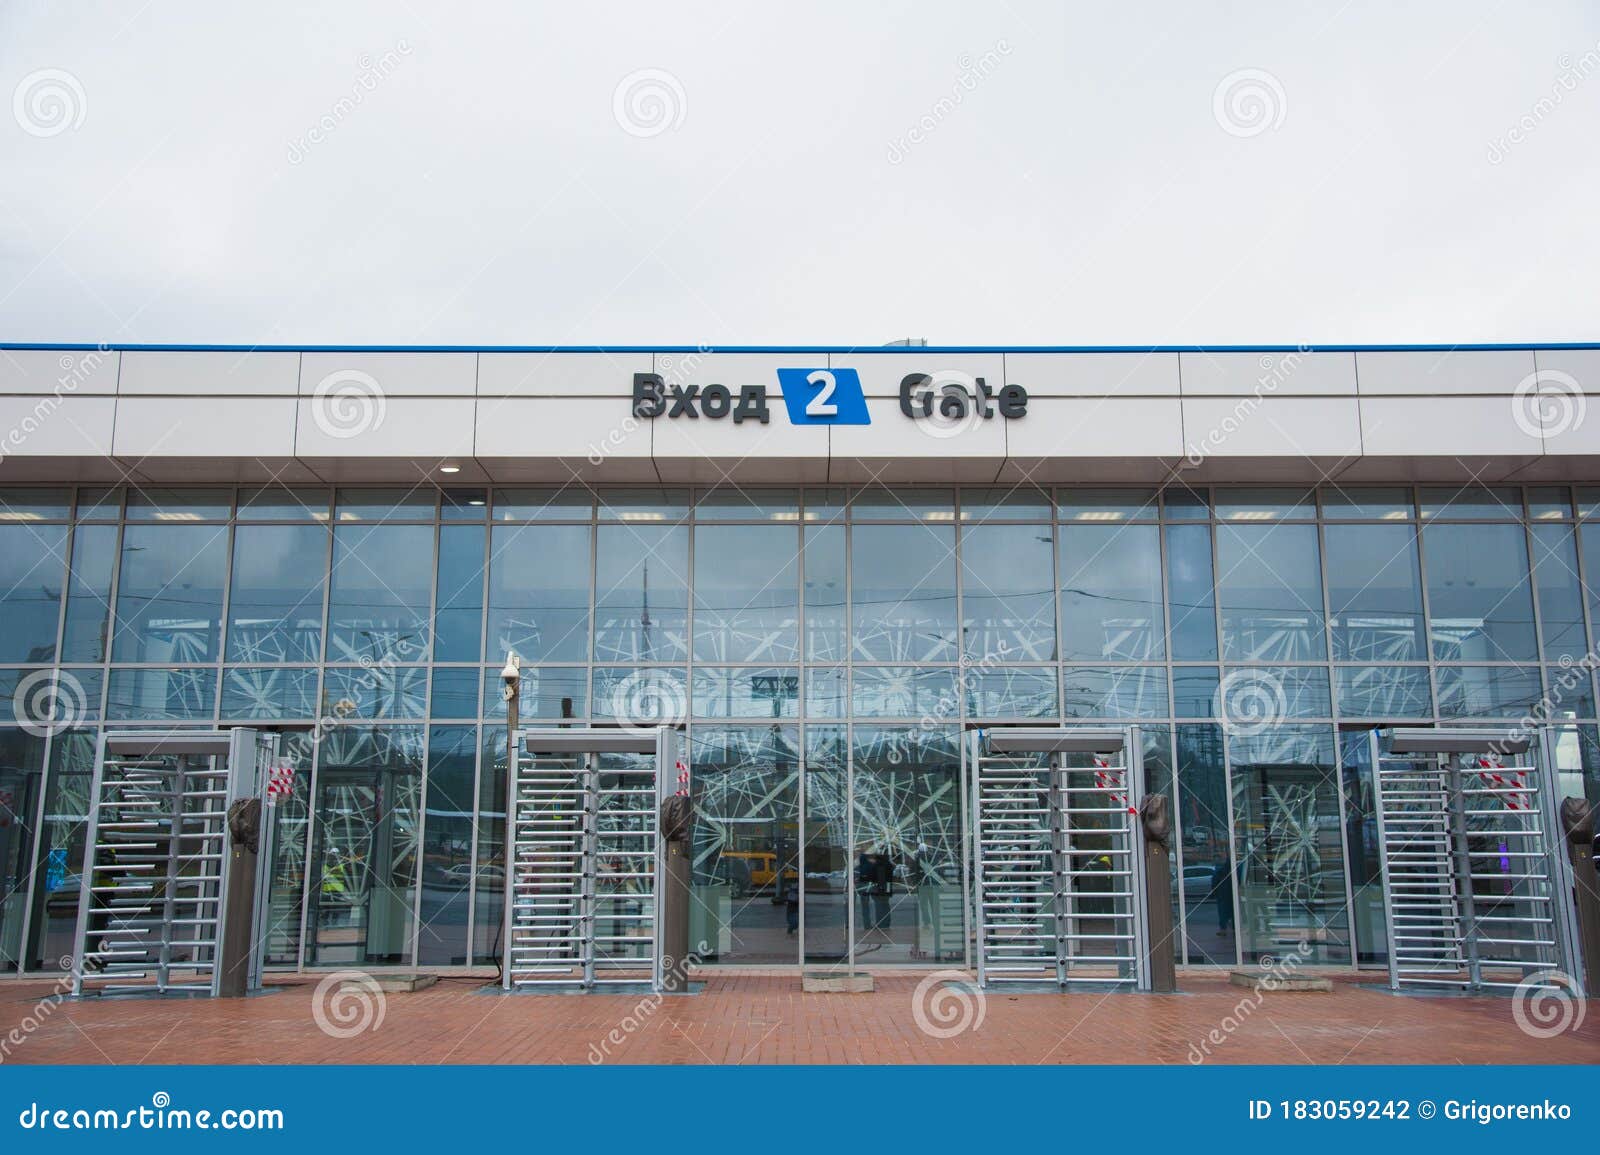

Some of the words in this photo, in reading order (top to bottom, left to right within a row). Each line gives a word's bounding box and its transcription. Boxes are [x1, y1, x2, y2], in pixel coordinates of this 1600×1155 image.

[632, 372, 770, 424] Вход
[805, 370, 838, 416] 2
[899, 373, 1028, 420] Gate
